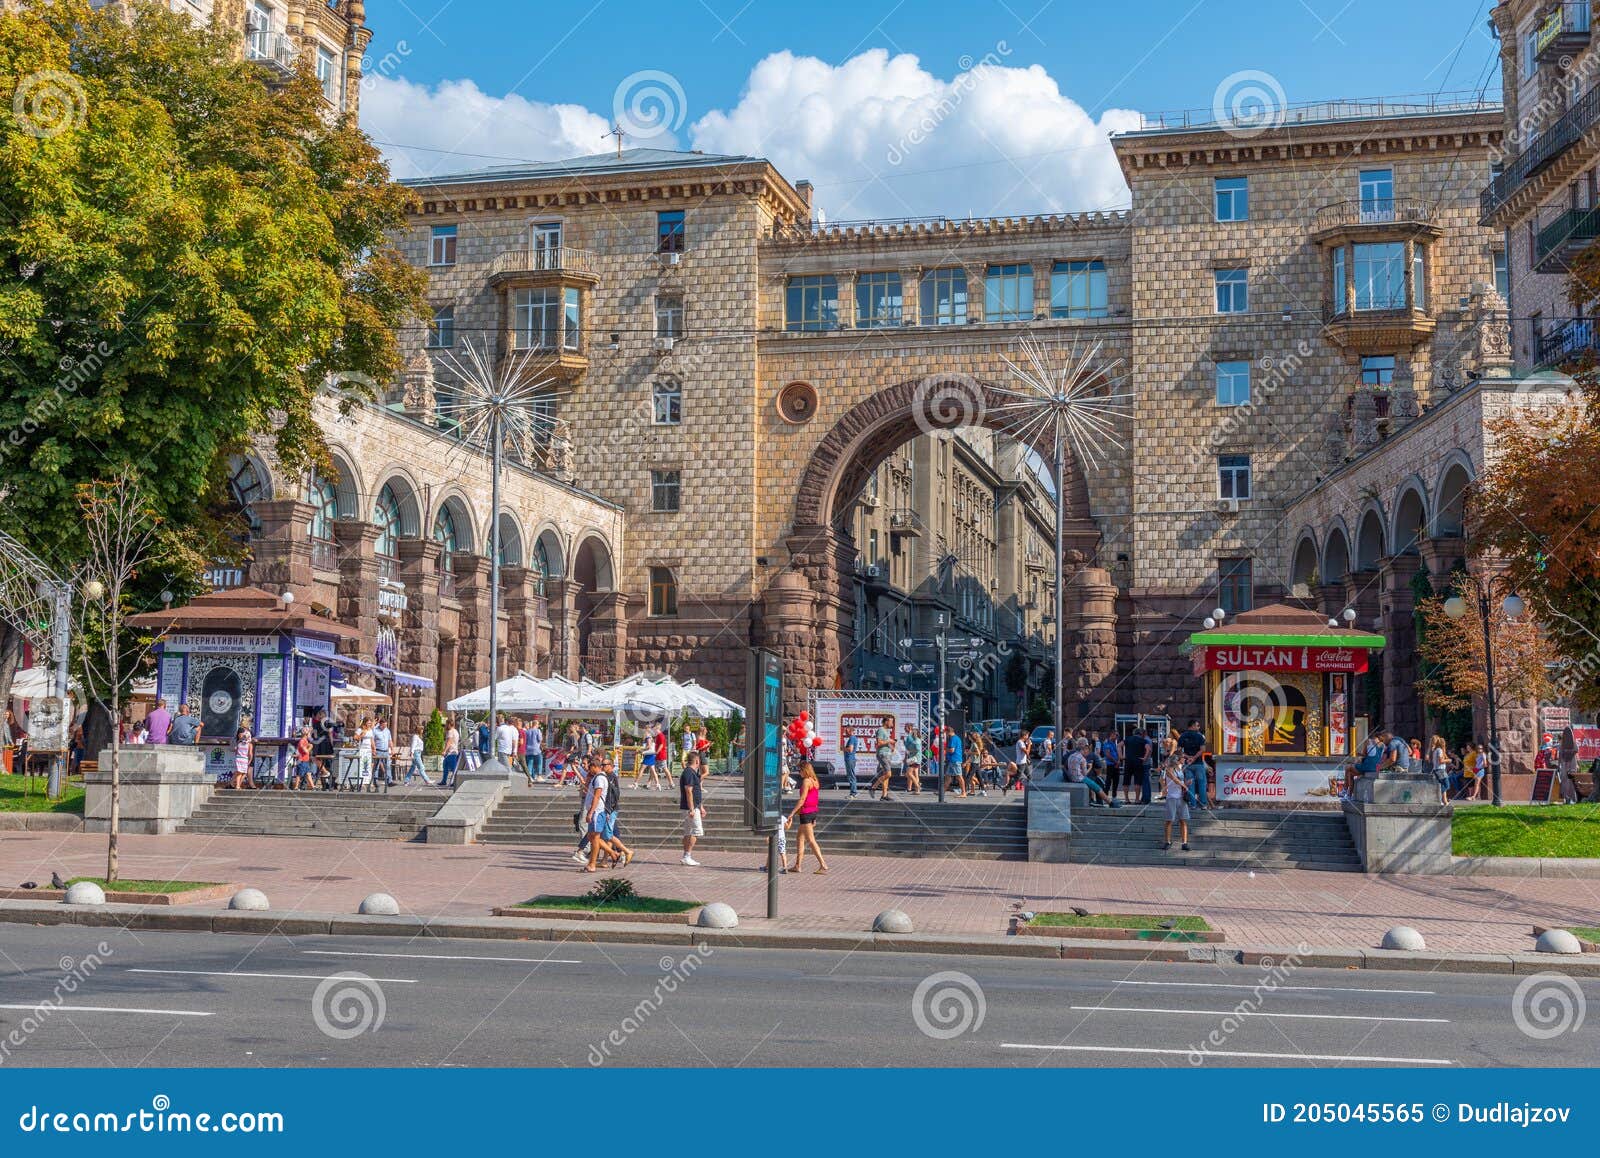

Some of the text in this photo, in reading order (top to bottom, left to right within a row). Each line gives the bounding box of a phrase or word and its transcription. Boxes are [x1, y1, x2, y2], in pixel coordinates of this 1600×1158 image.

[172, 635, 244, 646] АЛЬТЕРНАТИВНА
[1216, 650, 1293, 666] SULTAN
[842, 717, 884, 726] БОЛЬШ
[1223, 787, 1286, 796] СМАЧНІШЕ!
